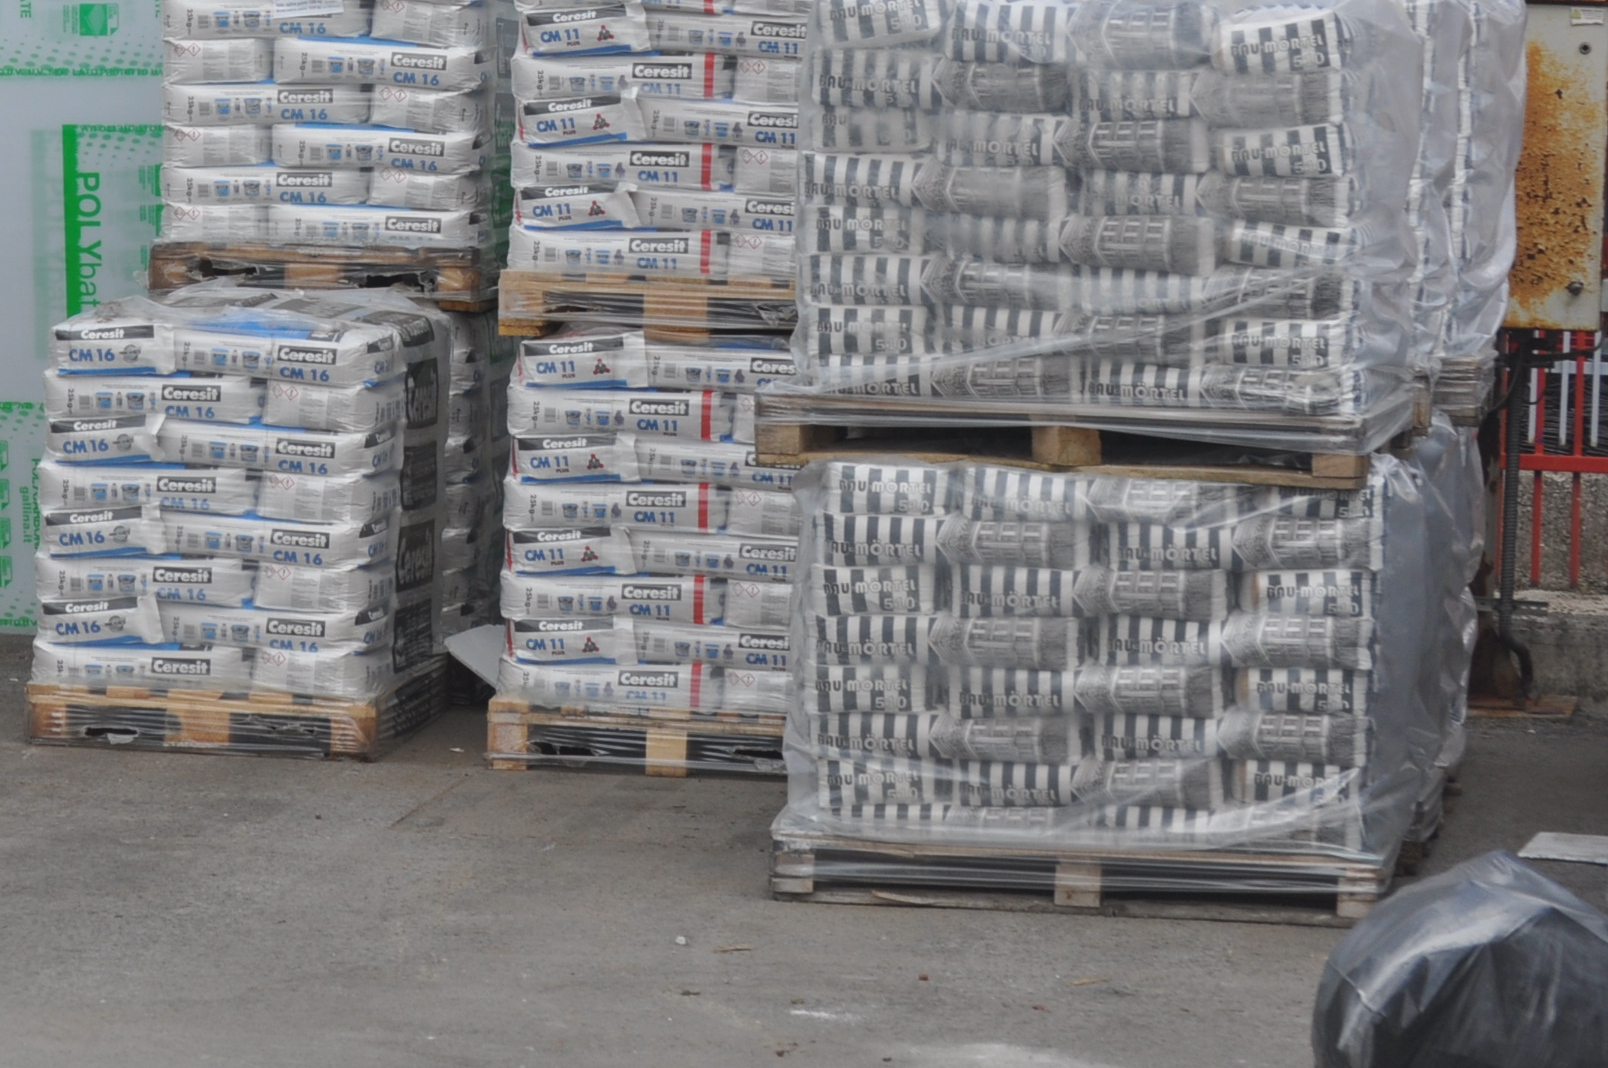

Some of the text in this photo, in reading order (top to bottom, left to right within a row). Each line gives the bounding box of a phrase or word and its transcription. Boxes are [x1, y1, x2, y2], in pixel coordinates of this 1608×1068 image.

[552, 10, 596, 22] Ceresit
[540, 29, 580, 43] CM 11
[393, 56, 444, 68] Ceresit
[634, 64, 690, 78] Ceresit
[279, 91, 331, 102] Ceresit
[281, 108, 327, 120] CM 16
[631, 153, 685, 165] Ceresit
[638, 170, 678, 183] CM 11
[387, 218, 439, 231] Ceresit
[631, 240, 684, 252] Ceresit
[81, 329, 124, 339] Ceresit
[69, 348, 115, 362] CM 16
[549, 343, 593, 354] Ceresit
[279, 348, 334, 363] Ceresit
[536, 361, 575, 374] CM 11
[280, 367, 329, 382] CM 16
[163, 387, 219, 401] Ceresit
[630, 401, 686, 414] Ceresit
[637, 419, 678, 431] CM 11
[543, 437, 586, 448] Ceresit
[278, 442, 333, 457] Ceresit
[530, 456, 569, 469] CM 11
[627, 493, 683, 506] Ceresit
[70, 512, 113, 523] Ceresit
[59, 531, 104, 546] CM 16
[272, 533, 327, 547] Ceresit
[273, 551, 322, 566] CM 16
[154, 569, 210, 582] Ceresit
[539, 620, 582, 631] Ceresit
